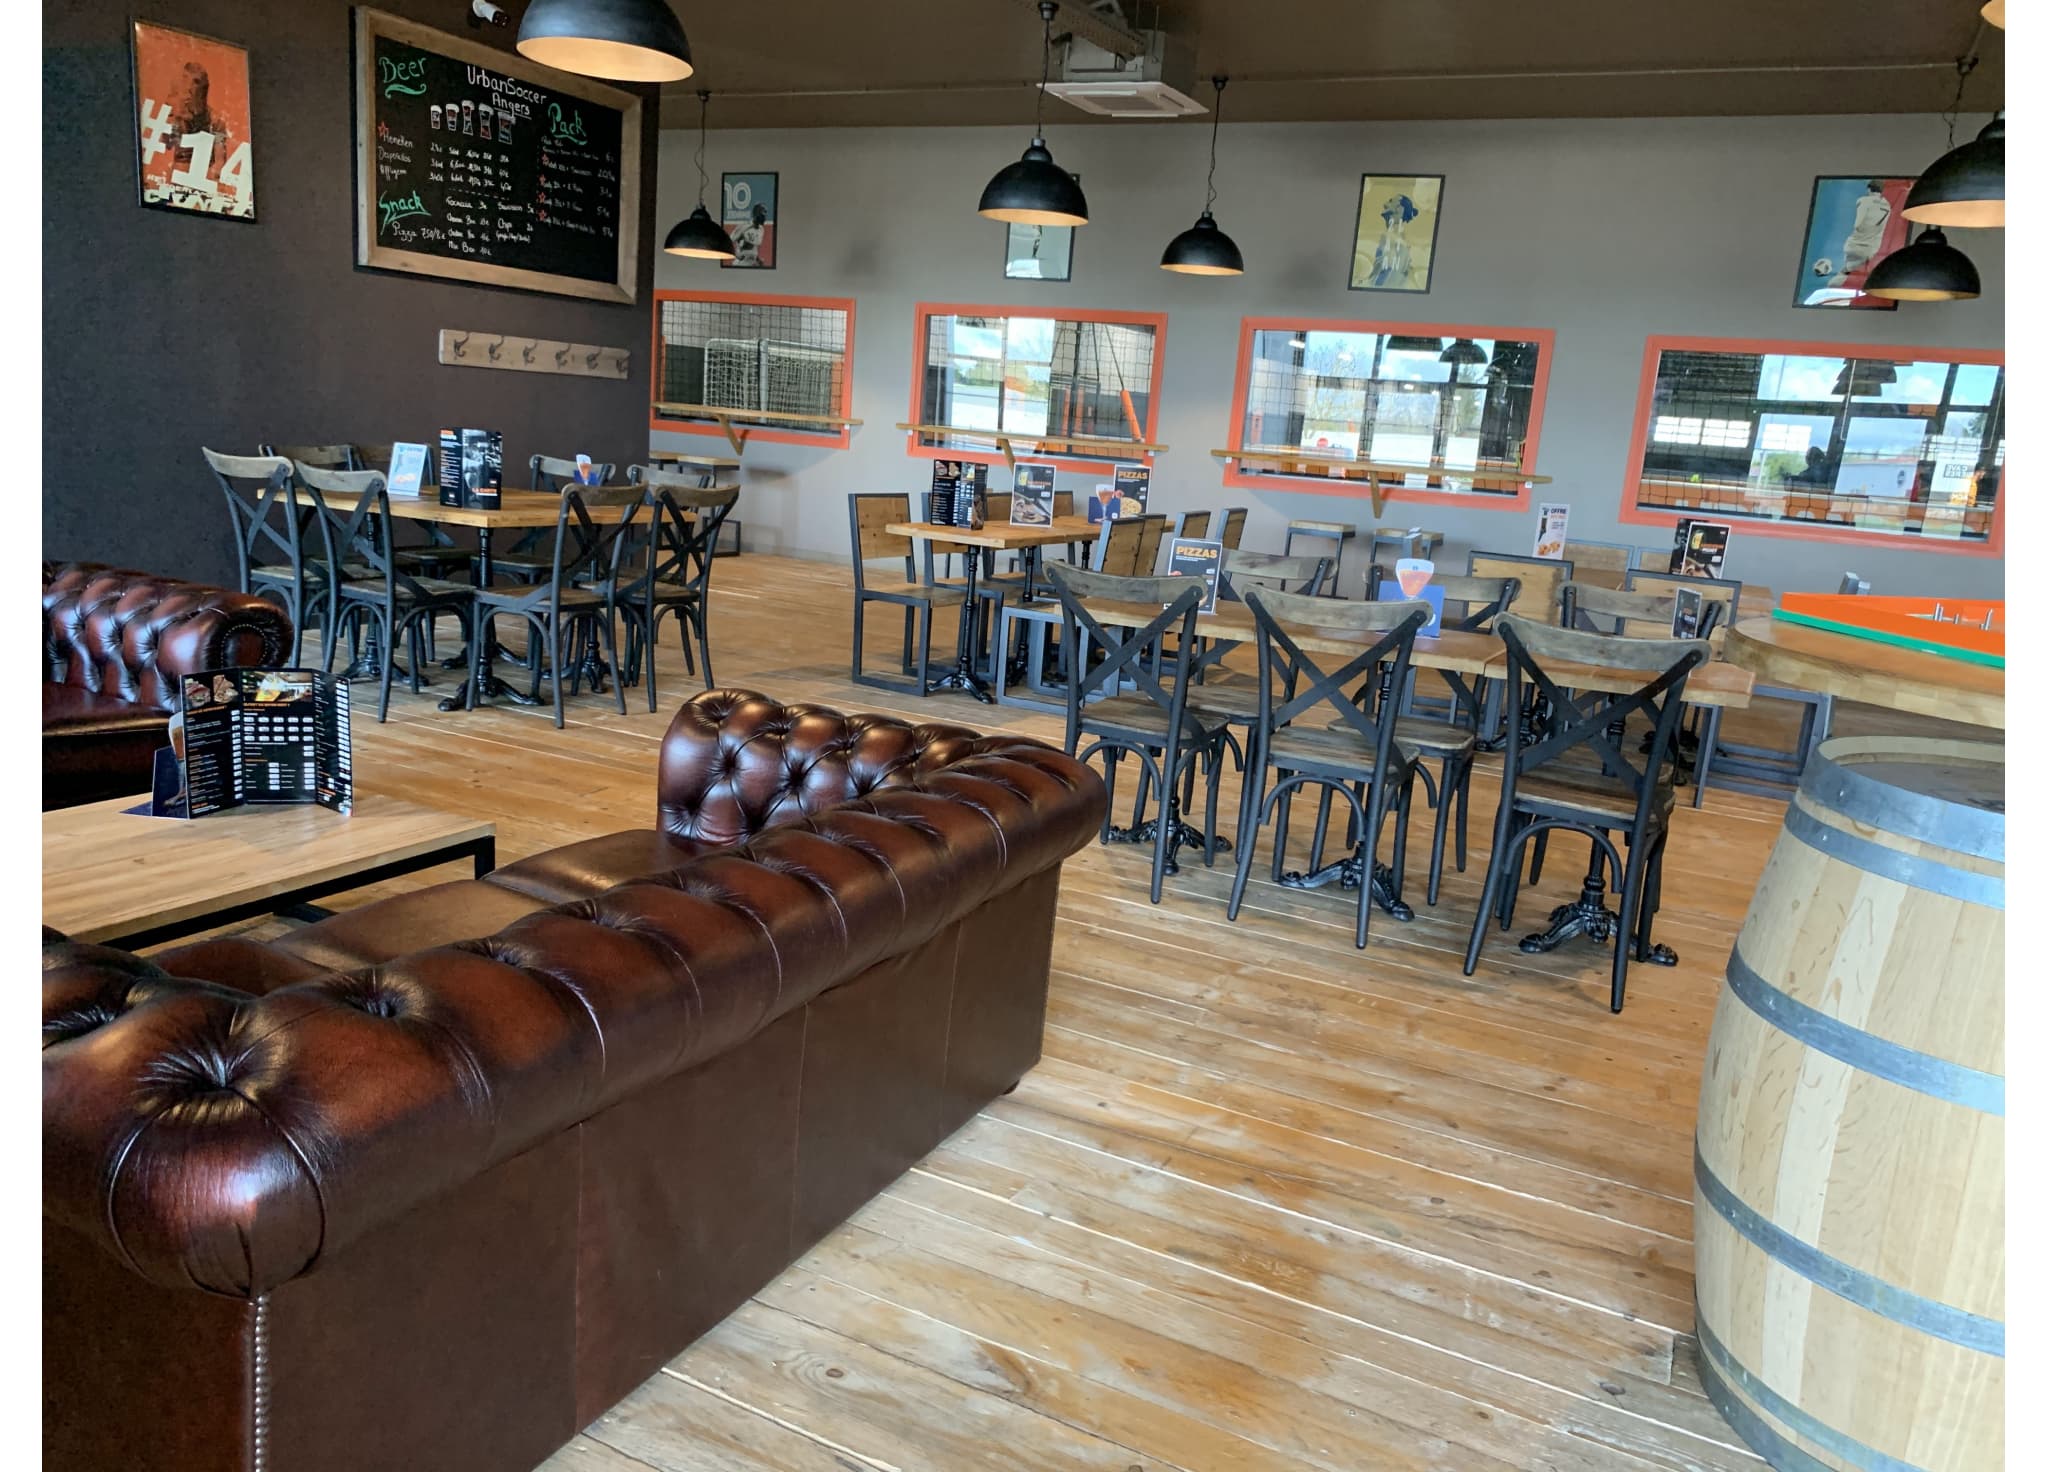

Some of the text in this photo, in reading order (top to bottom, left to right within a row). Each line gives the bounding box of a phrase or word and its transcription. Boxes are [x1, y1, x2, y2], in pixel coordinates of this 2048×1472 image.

[379, 56, 427, 83] Beer
[467, 65, 547, 105] UrbanSoccer
[492, 92, 530, 117] Angers
[548, 102, 586, 137] Pack
[379, 190, 429, 221] Snack
[724, 182, 751, 210] 10
[1876, 207, 1889, 226] 7
[1118, 471, 1147, 480] PIZZAS
[1176, 546, 1217, 559] PIZZAS
